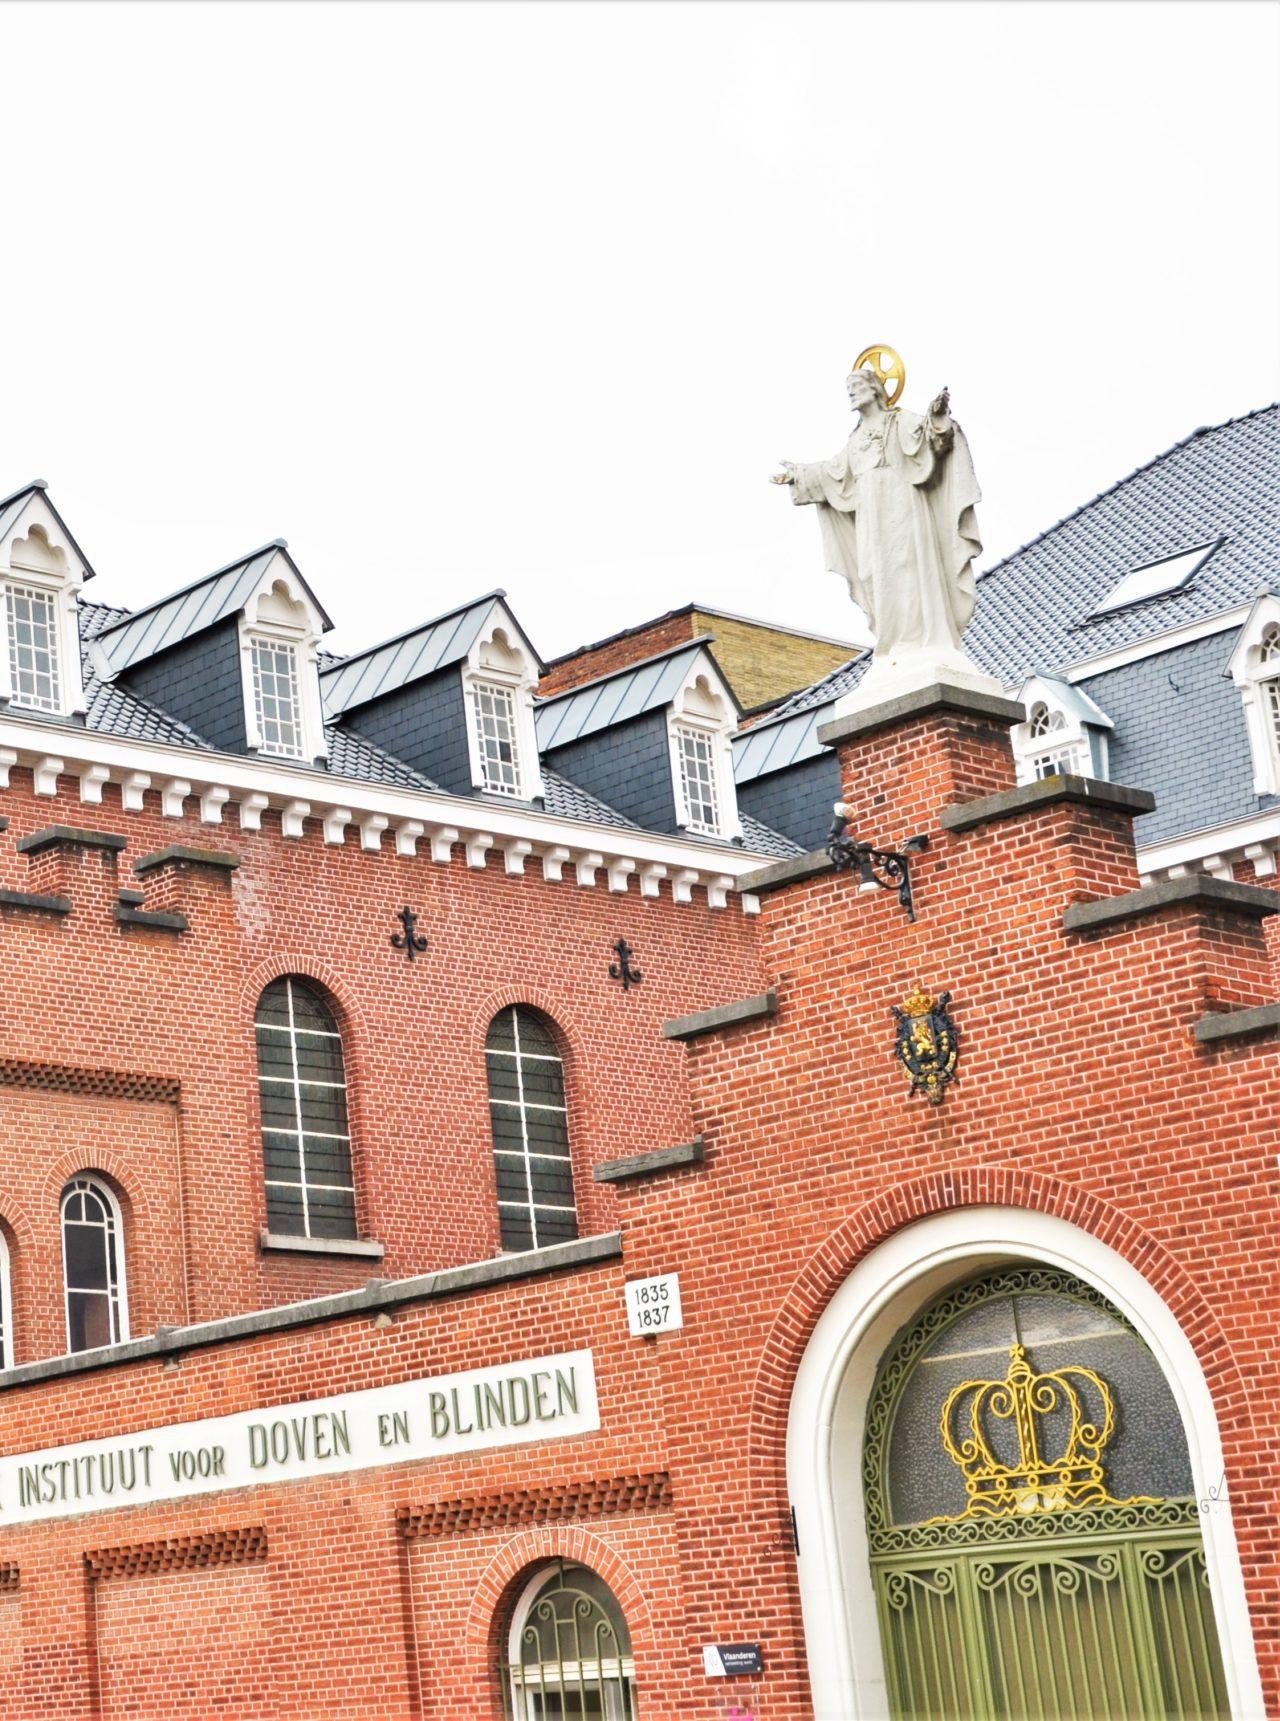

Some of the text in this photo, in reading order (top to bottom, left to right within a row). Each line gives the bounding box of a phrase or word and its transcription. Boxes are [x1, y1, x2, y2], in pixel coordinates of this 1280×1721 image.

[635, 1282, 669, 1305] 1835
[637, 1305, 670, 1328] 1837
[18, 1444, 154, 1507] INSTITUUT
[168, 1445, 225, 1482] VOOR
[247, 1409, 351, 1470] DOVEN
[377, 1410, 410, 1447] EN
[428, 1366, 581, 1439] BLINDEN
[723, 1652, 756, 1660] Vlaanderen
